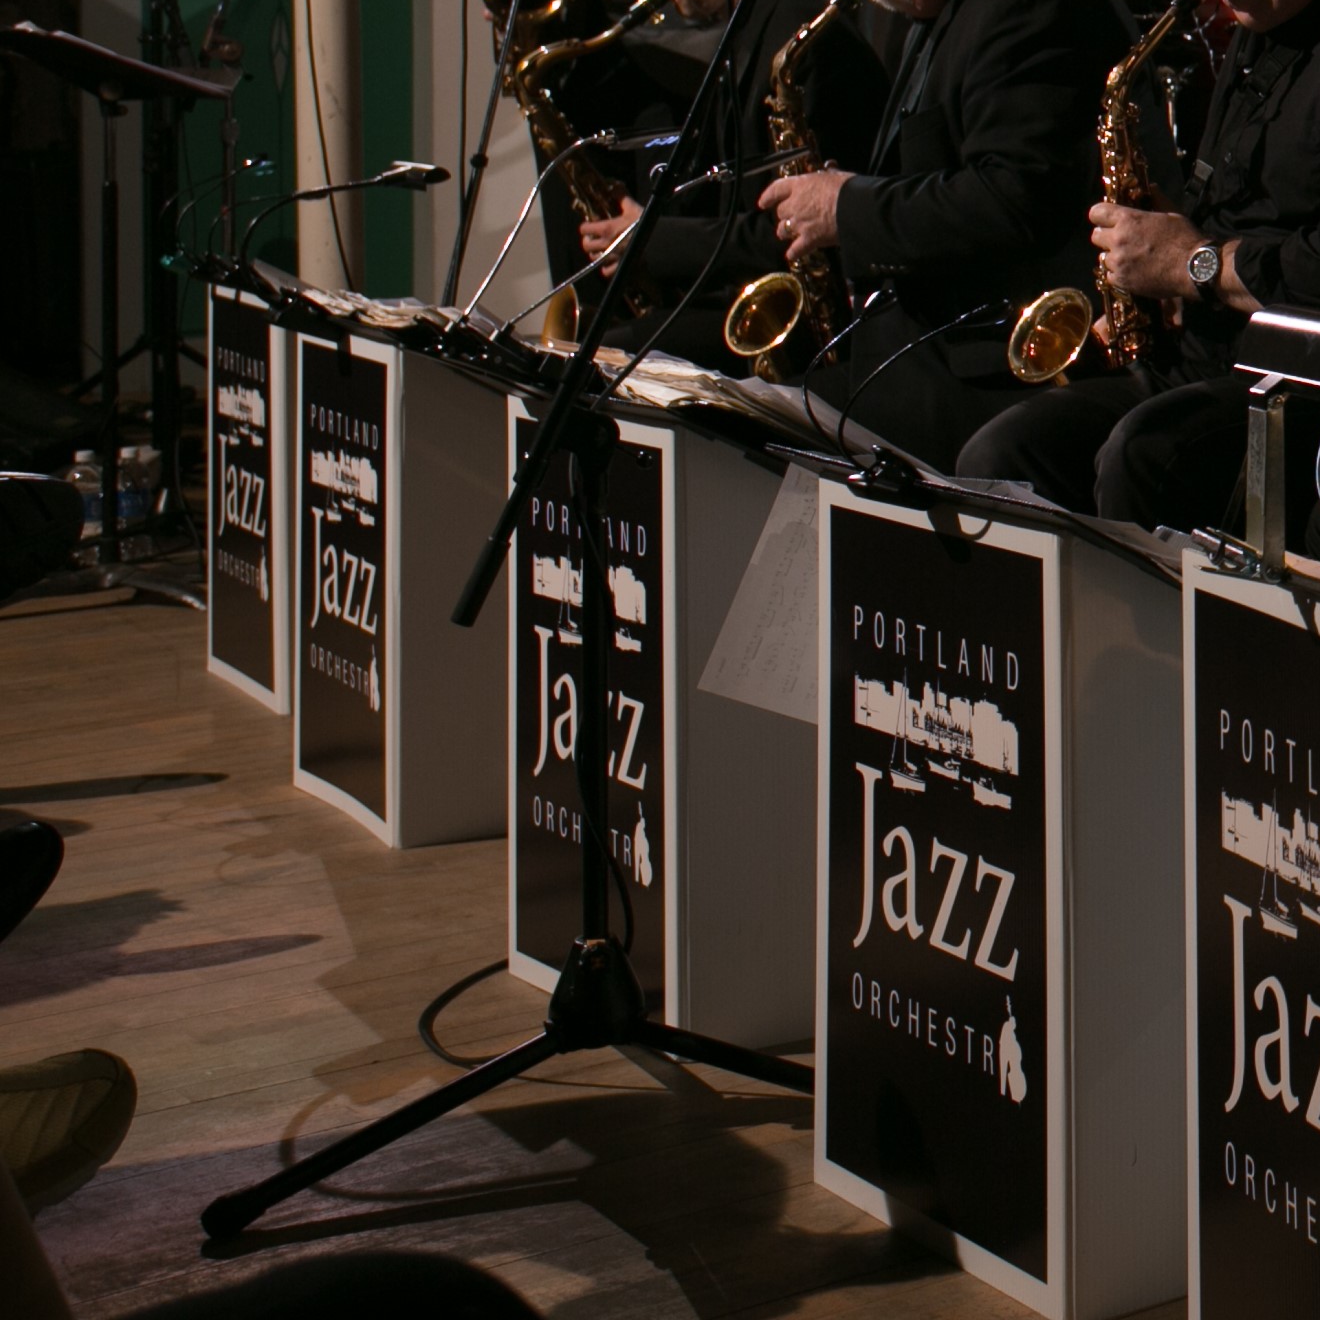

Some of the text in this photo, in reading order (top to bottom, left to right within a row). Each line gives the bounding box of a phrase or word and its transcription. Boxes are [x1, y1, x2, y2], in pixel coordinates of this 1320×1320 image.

[217, 345, 266, 383] PORTLAND
[310, 402, 380, 451] PORTLAND
[217, 433, 267, 538] Jazz
[310, 506, 379, 636] Jazz
[854, 604, 1020, 691] PORTLAND
[533, 624, 648, 791] Jaz
[853, 761, 1020, 982] Jazz
